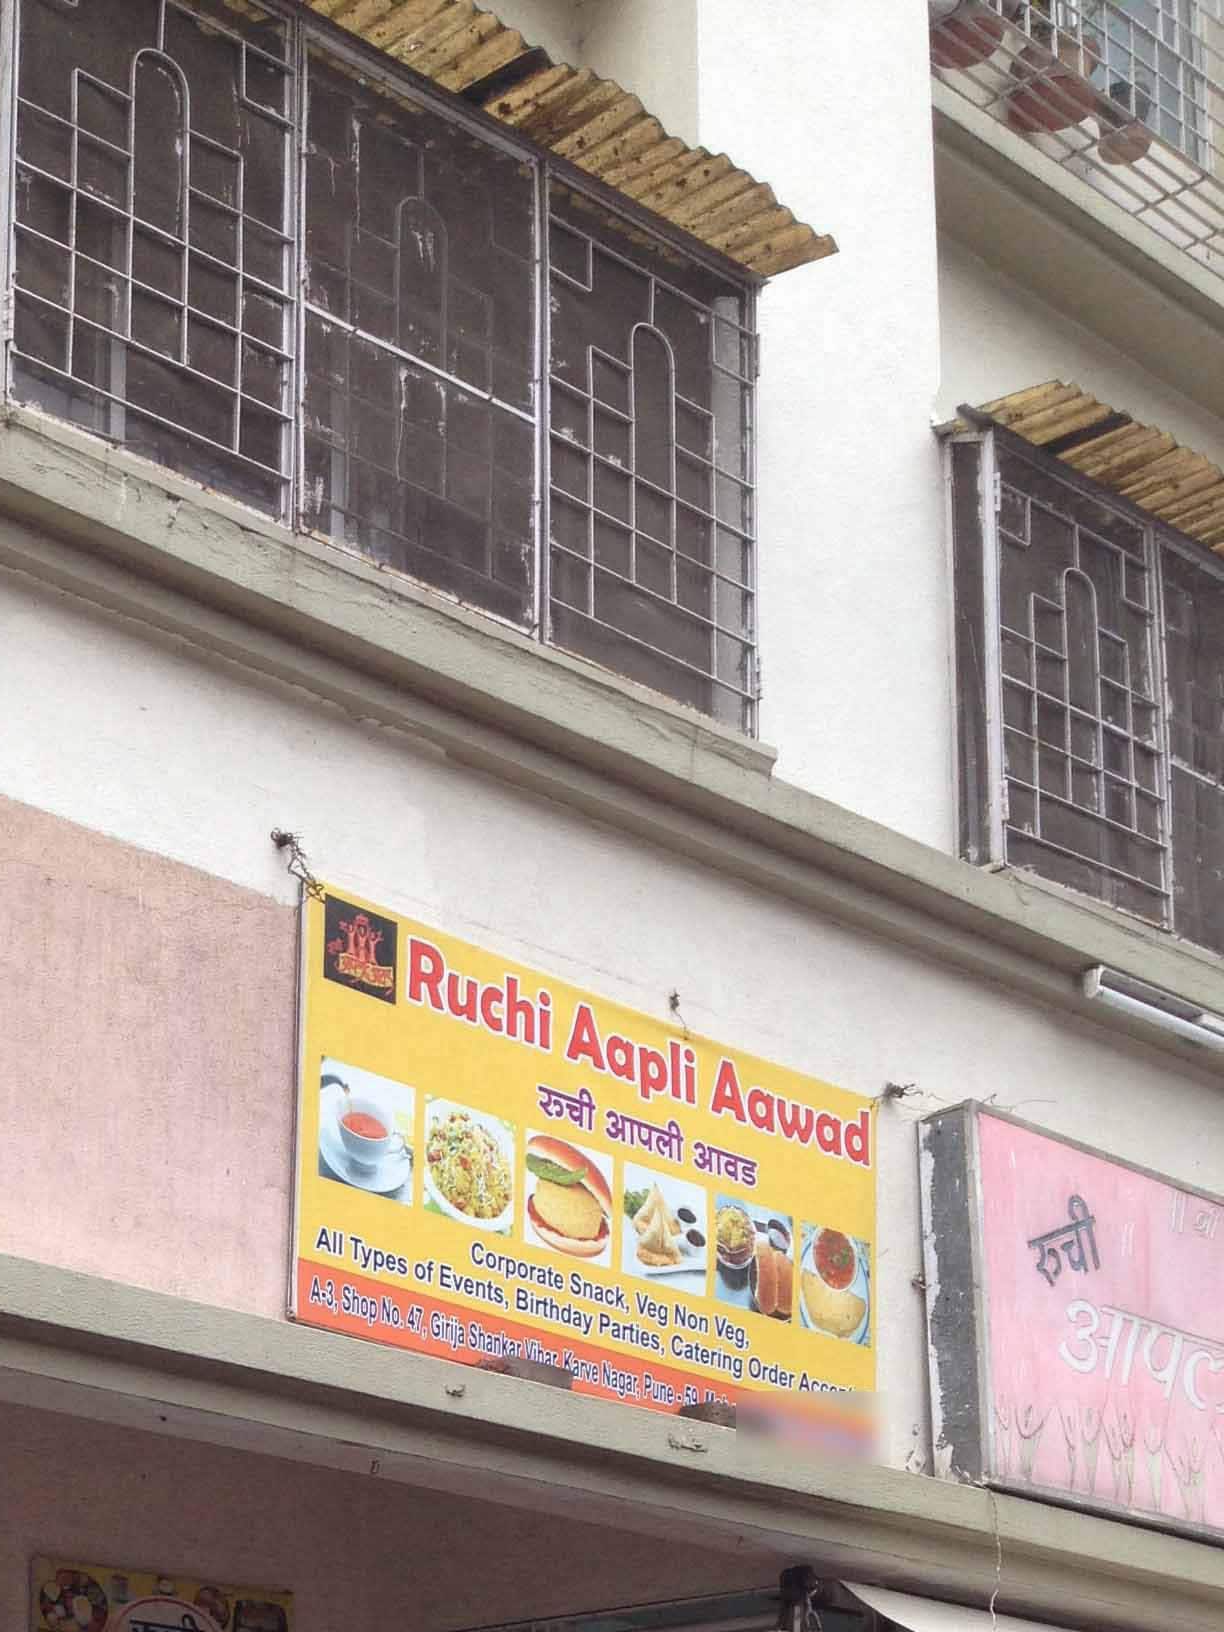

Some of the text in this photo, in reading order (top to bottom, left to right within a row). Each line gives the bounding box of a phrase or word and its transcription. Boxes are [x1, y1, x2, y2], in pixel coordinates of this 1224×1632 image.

[408, 938, 551, 1050] Ruchi
[567, 1005, 696, 1104] Aapli
[712, 1060, 870, 1166] Aawad
[538, 1086, 757, 1185] रुची आपली आवड
[471, 1243, 749, 1349] Corporate Snack, Veg Non Veg,
[1027, 1194, 1100, 1287] रुची
[310, 1277, 337, 1312] A-3,
[342, 1287, 376, 1322] Shop
[382, 1298, 403, 1327] No.
[408, 1305, 426, 1337] 47,
[431, 1313, 464, 1349] Girija
[469, 1323, 521, 1358] Shankar
[564, 1351, 598, 1382] Karve
[603, 1360, 640, 1398] Nagar,
[644, 1379, 673, 1403] Pune
[316, 1228, 343, 1255] All
[350, 1237, 408, 1273] Types
[414, 1261, 434, 1282] of
[440, 1265, 509, 1309] Events,
[516, 1289, 593, 1335] Birthday
[599, 1315, 664, 1355] Parties,
[671, 1336, 743, 1378] Catering
[749, 1358, 794, 1389] Order
